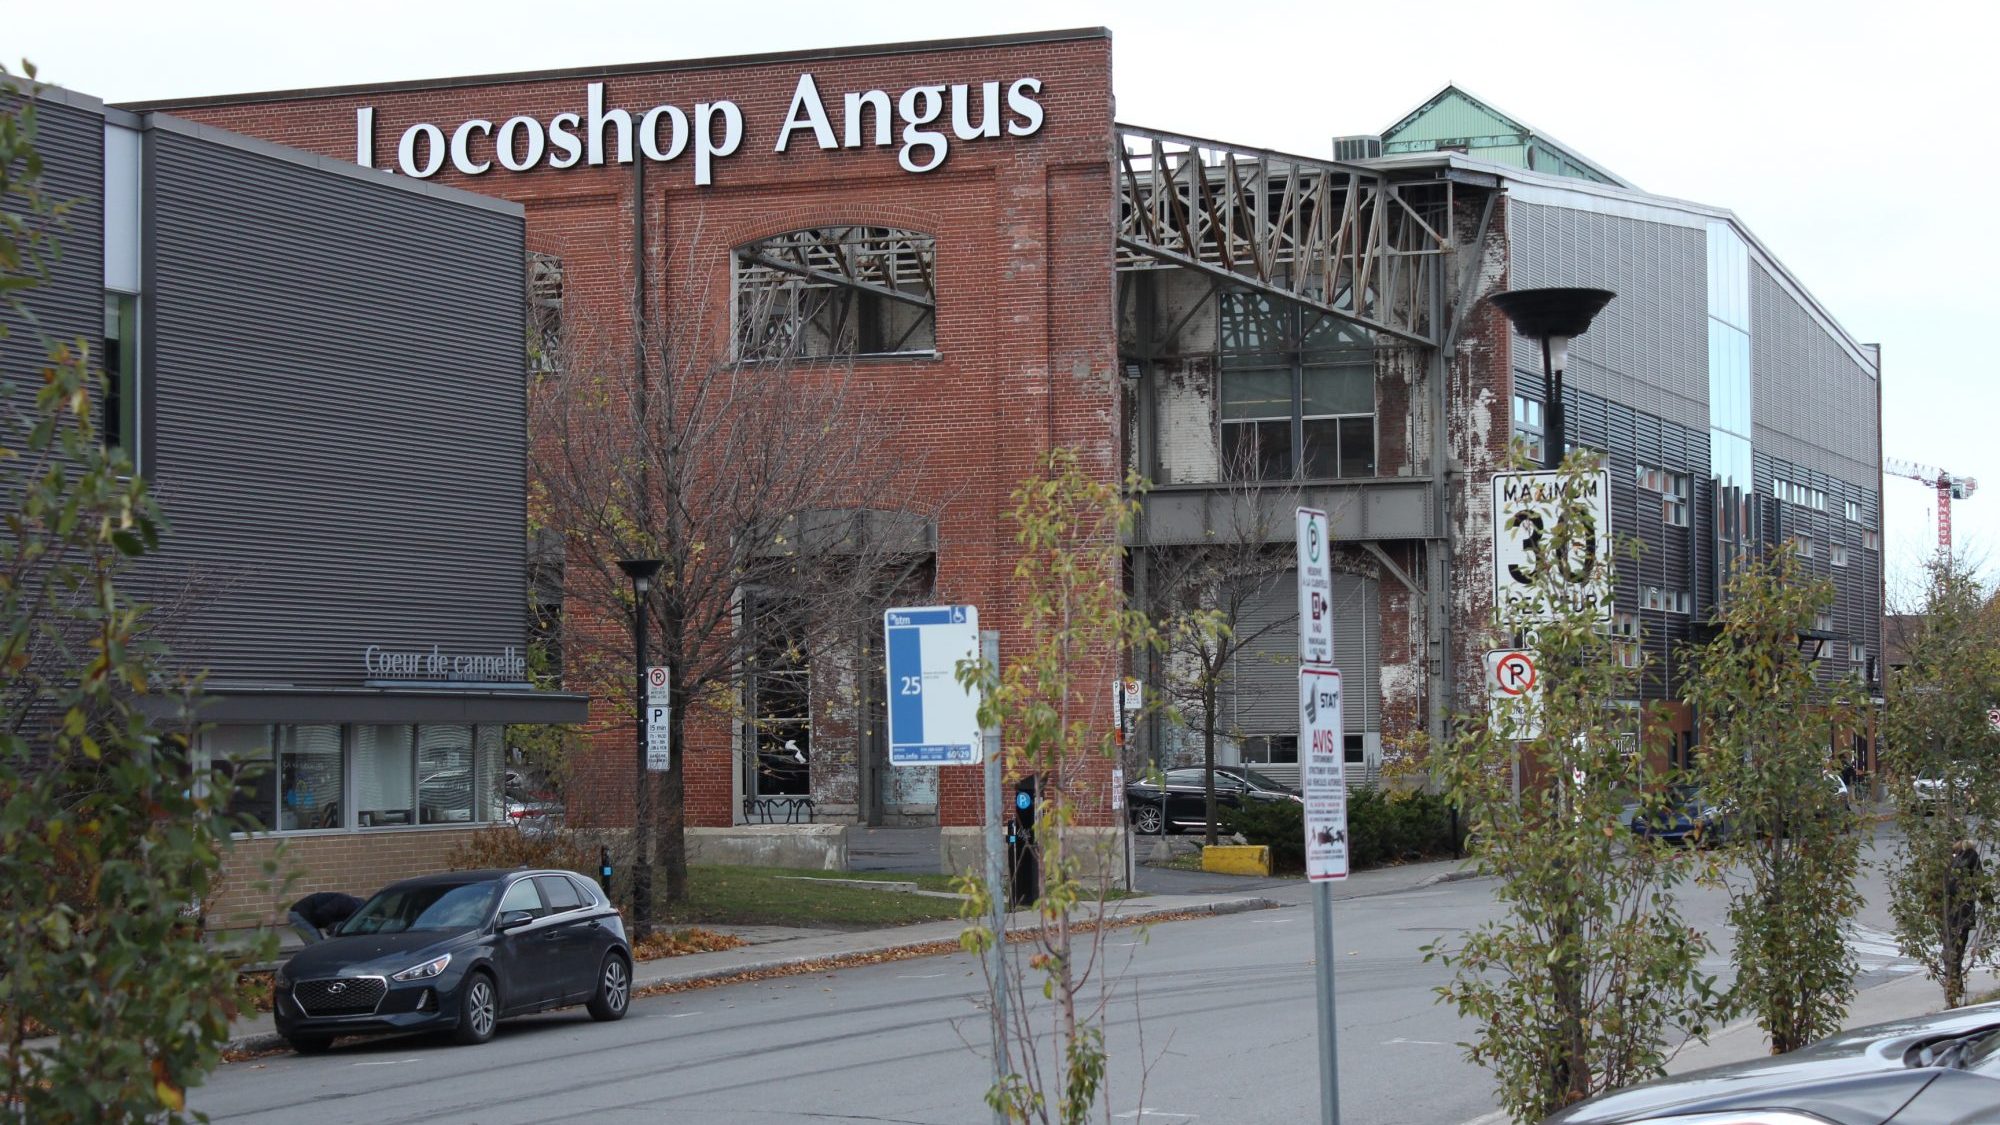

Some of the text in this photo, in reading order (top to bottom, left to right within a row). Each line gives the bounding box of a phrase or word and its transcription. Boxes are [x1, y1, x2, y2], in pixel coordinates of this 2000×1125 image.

[357, 73, 1045, 185] Locoshop Angus
[1508, 509, 1596, 584] 30
[1508, 593, 1597, 614] SECEUR
[365, 645, 525, 676] Coeur de cannelle
[901, 676, 921, 695] 25
[1510, 664, 1524, 685] P
[654, 709, 663, 723] P
[1312, 729, 1334, 753] AVIS
